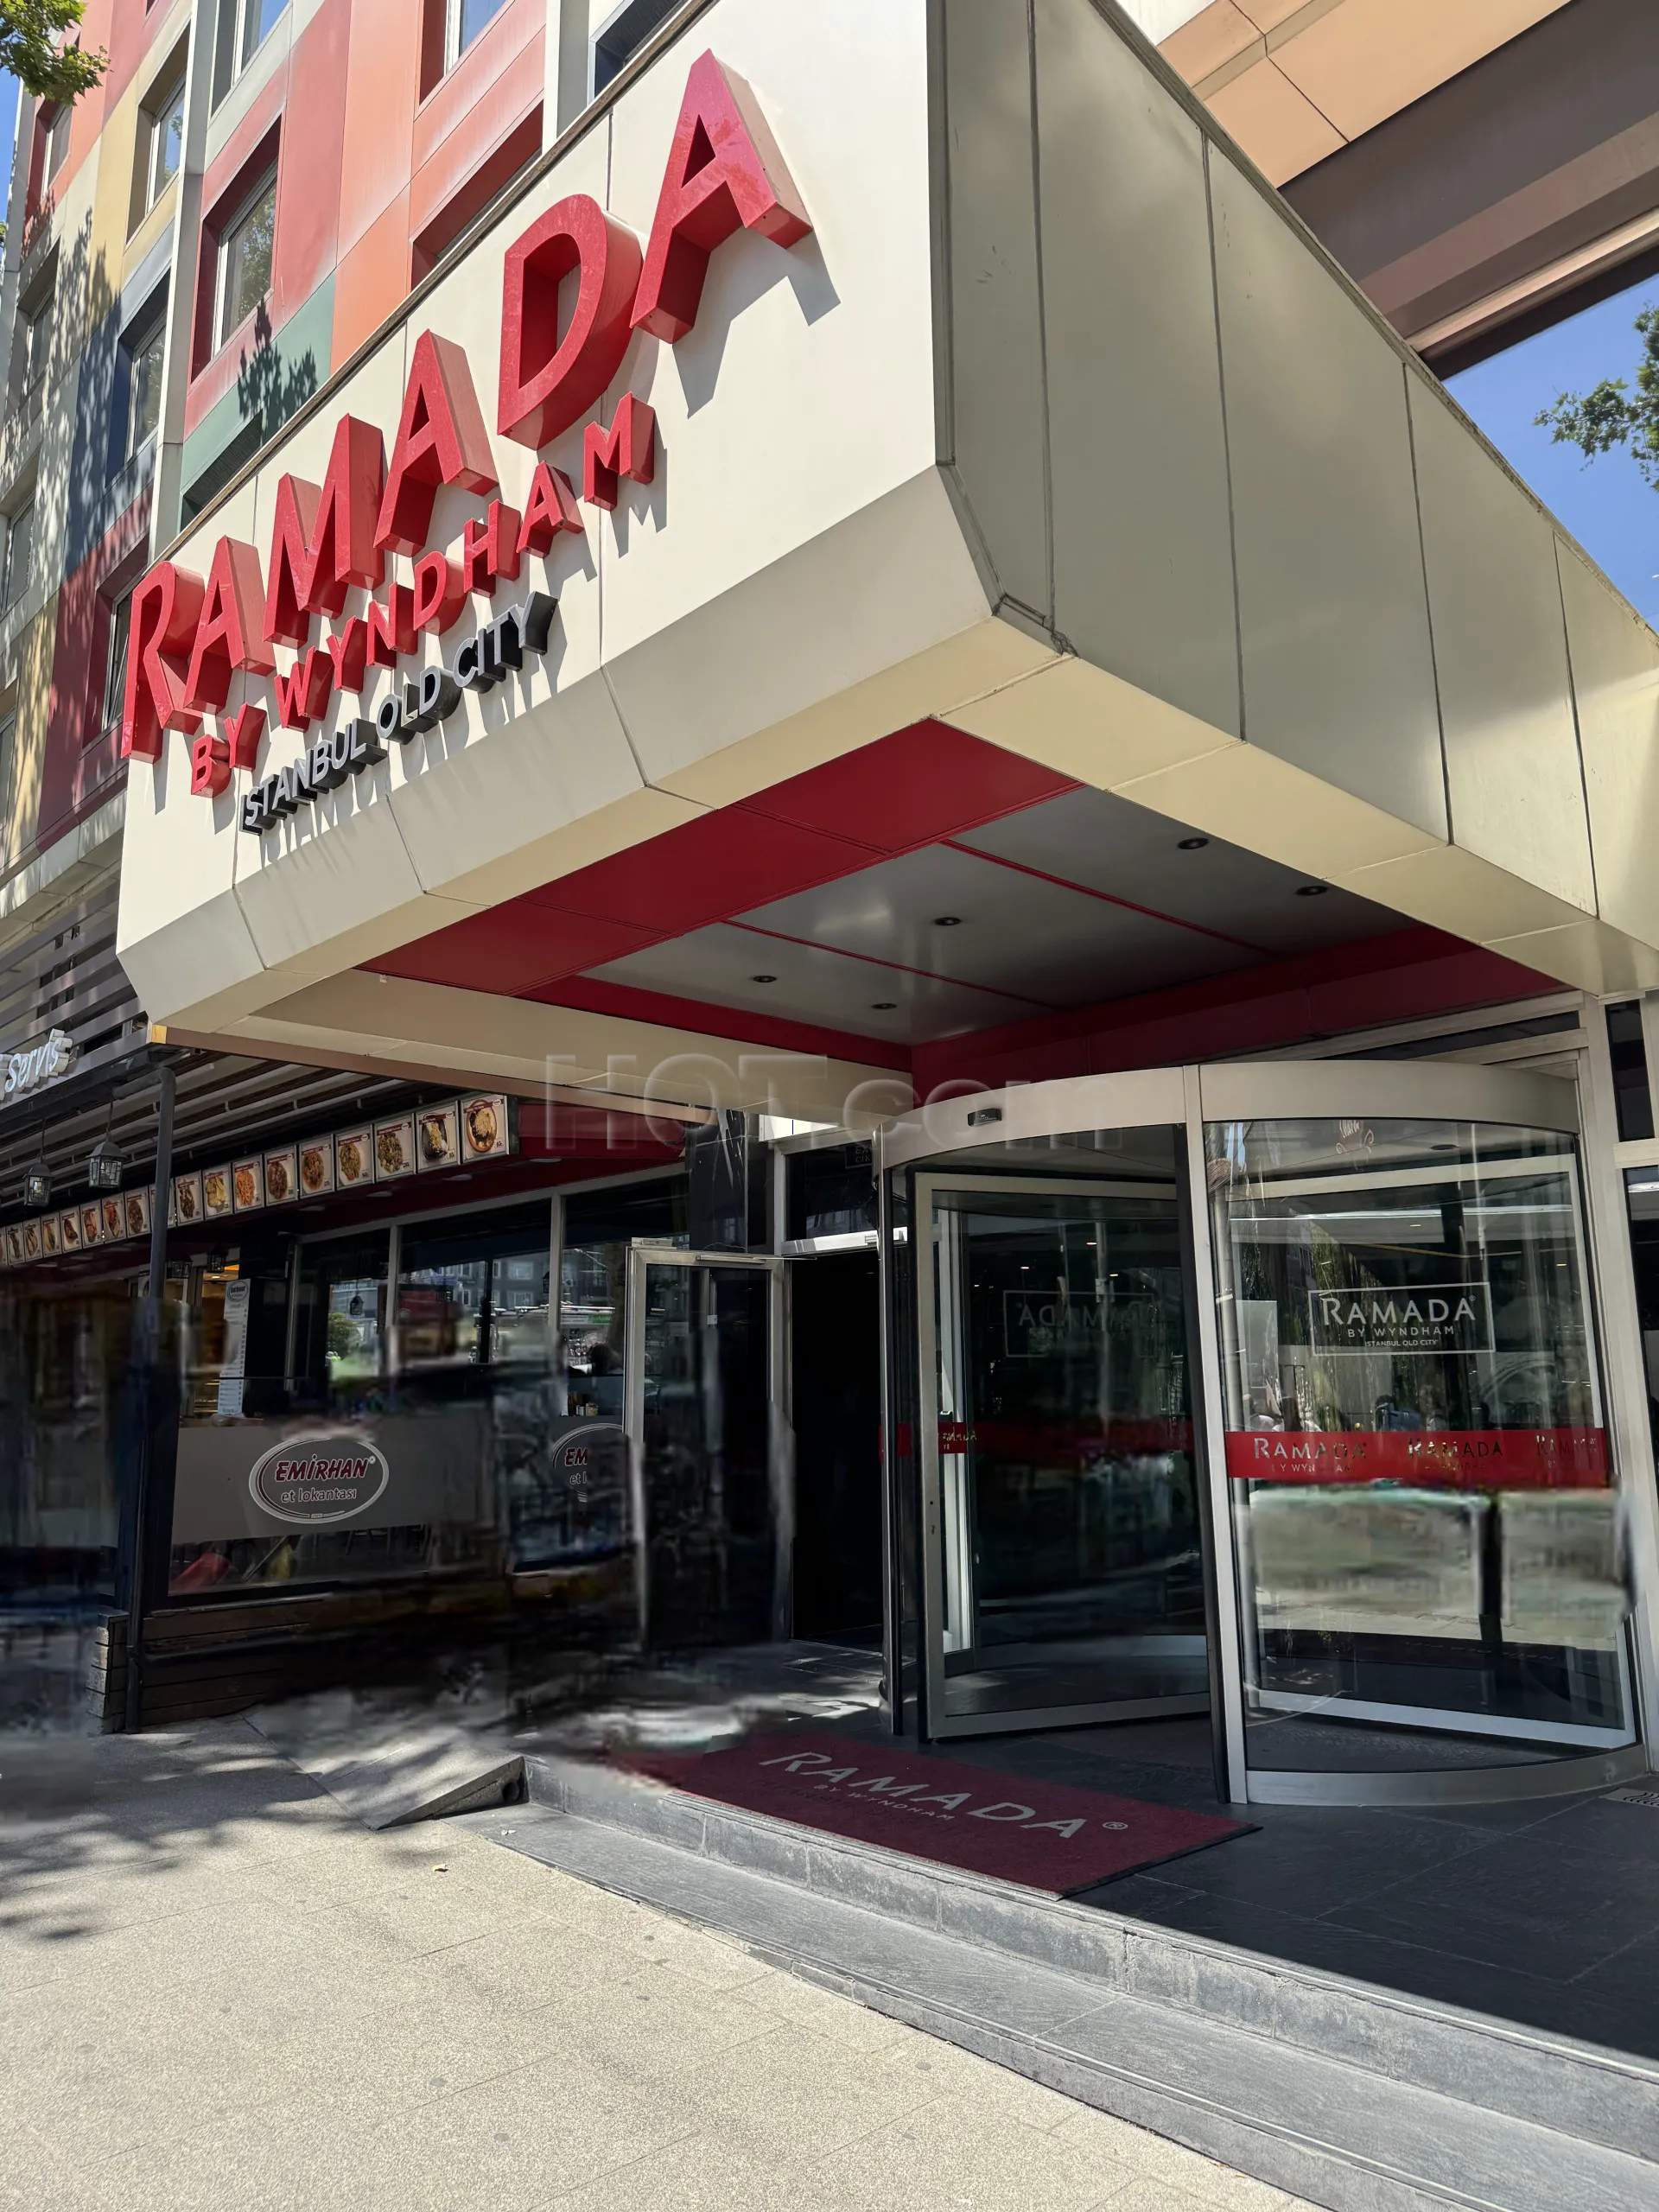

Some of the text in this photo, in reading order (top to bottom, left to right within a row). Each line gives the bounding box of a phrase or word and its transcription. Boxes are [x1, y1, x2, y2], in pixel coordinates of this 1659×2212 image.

[121, 48, 810, 763] RAMADA
[191, 391, 655, 798] BY WYNDHAM
[376, 664, 462, 746] OLD
[453, 591, 558, 694] CITY
[1322, 1296, 1478, 1325] RAMADA
[1347, 1325, 1455, 1338] BY WYNDHAM
[282, 1490, 296, 1503] et
[759, 1750, 1087, 1839] RAMADA
